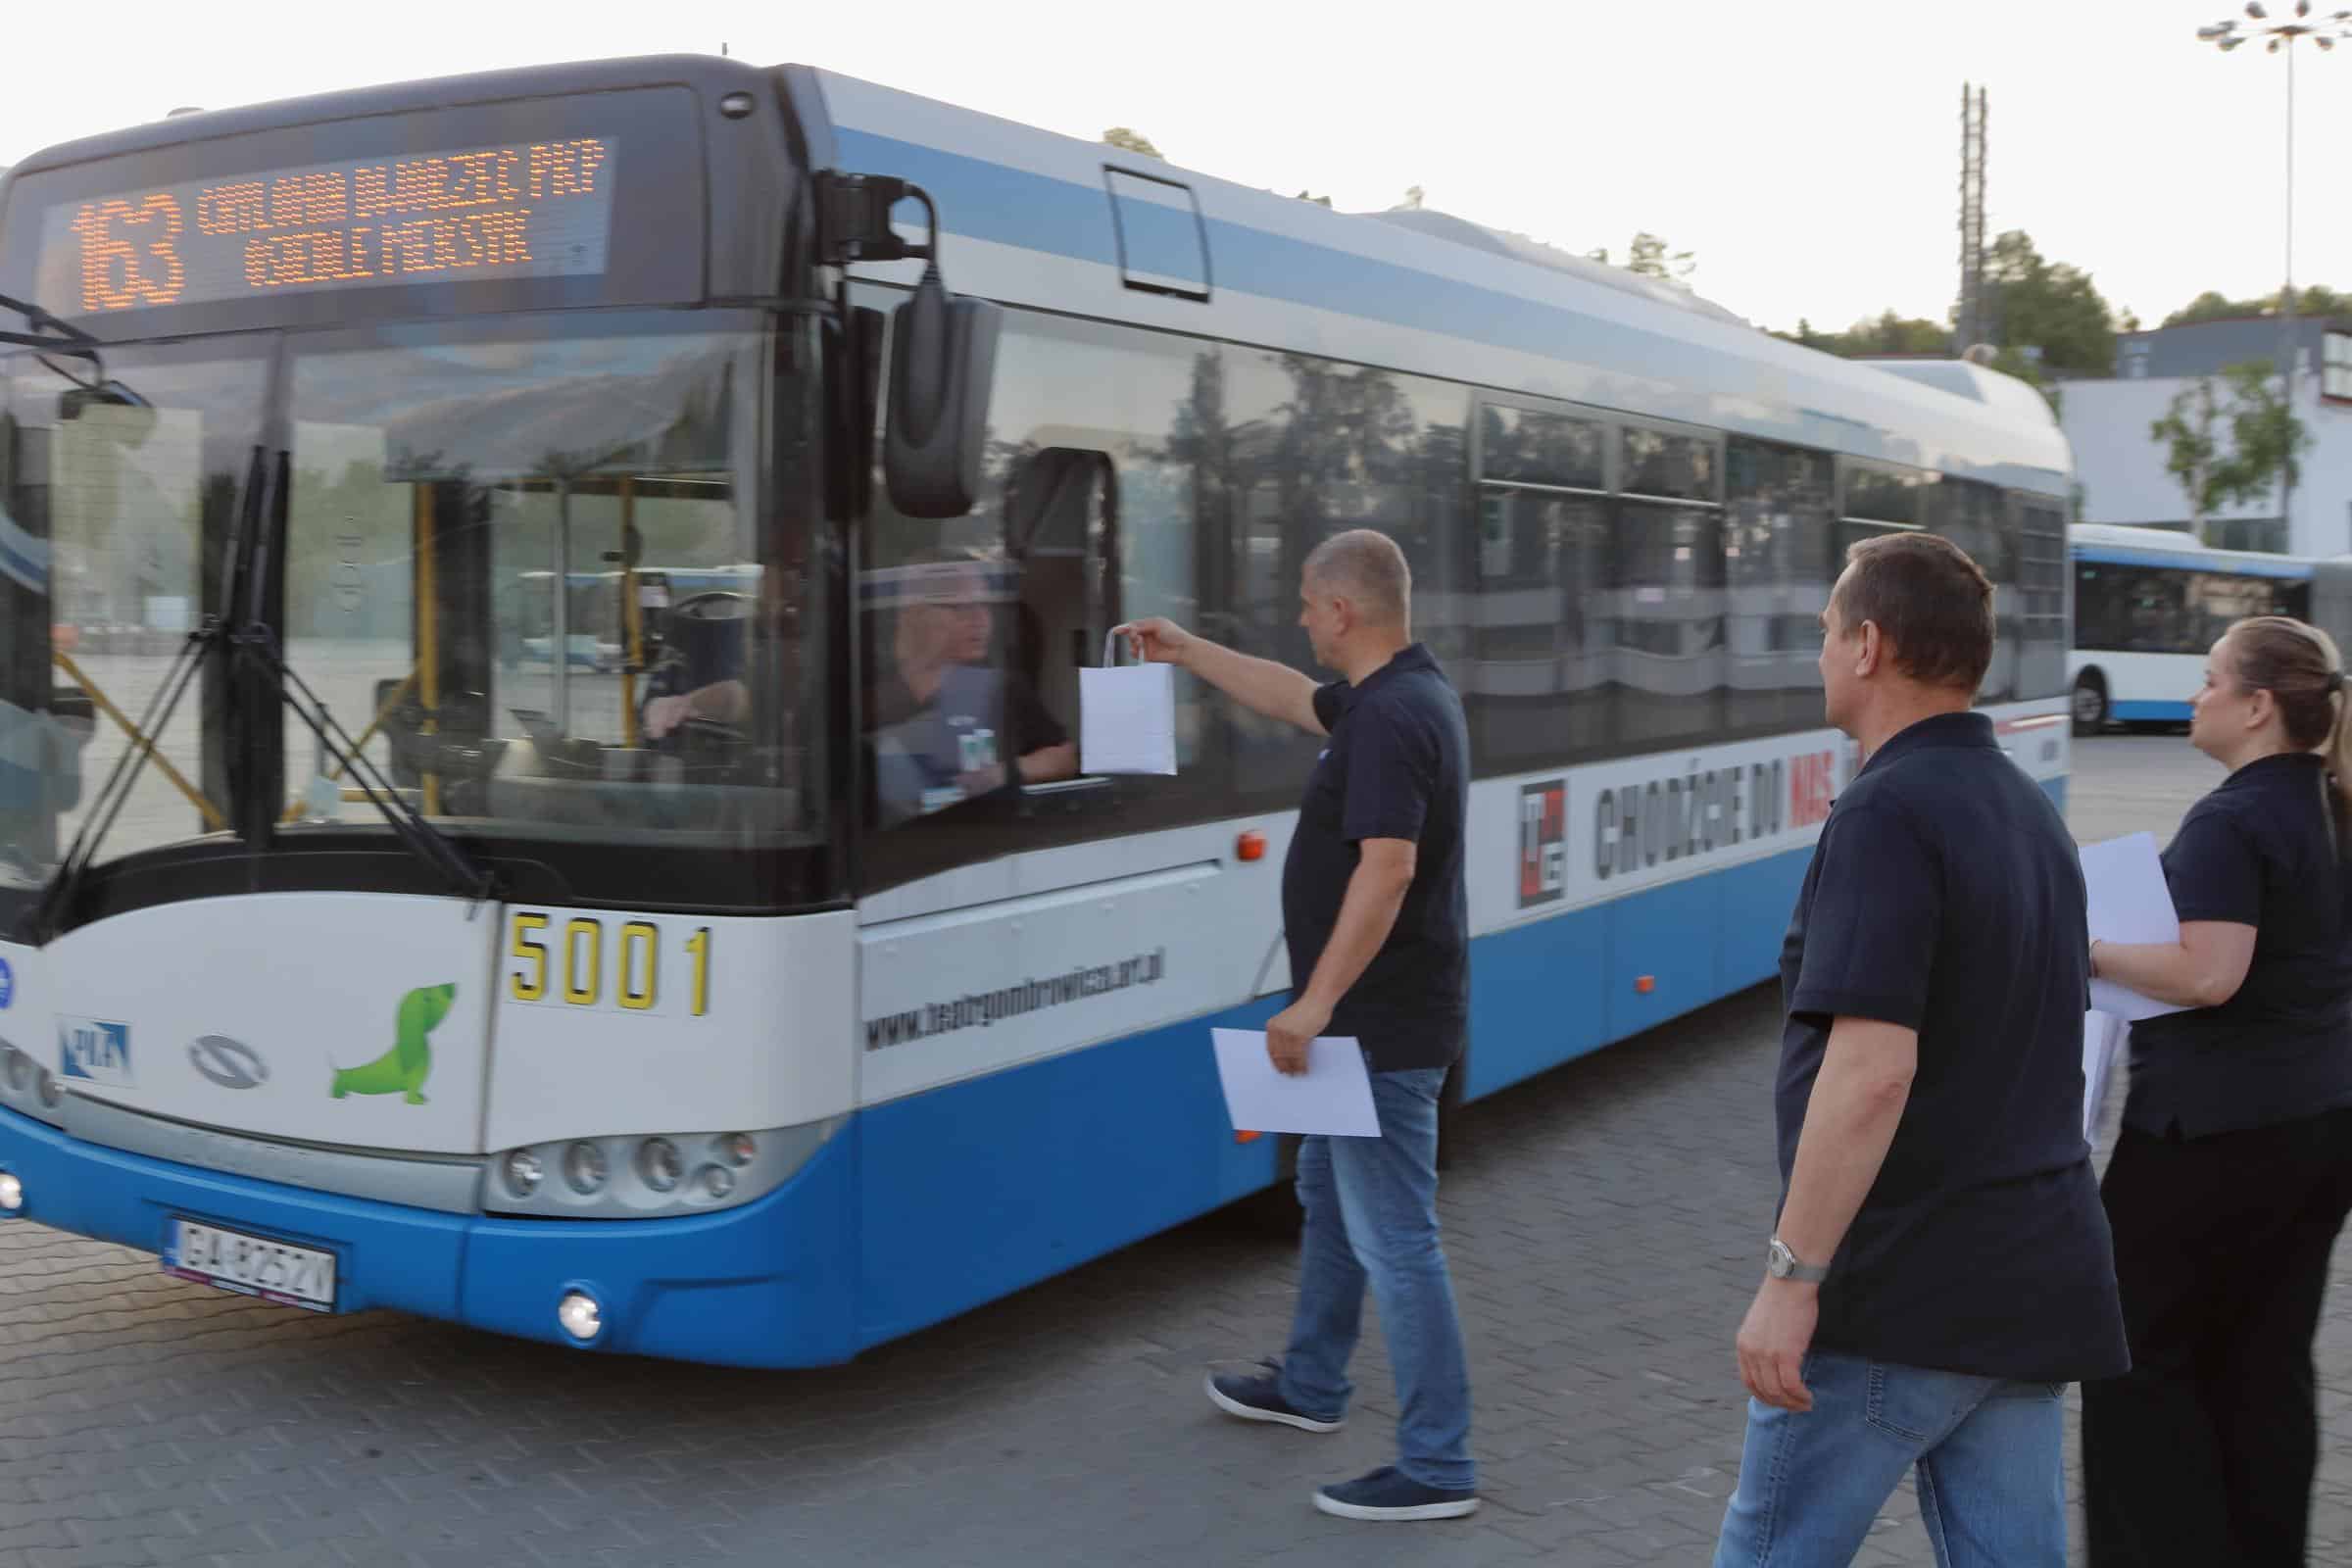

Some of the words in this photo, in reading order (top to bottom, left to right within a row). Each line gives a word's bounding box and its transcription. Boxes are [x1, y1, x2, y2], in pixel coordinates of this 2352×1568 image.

[530, 139, 605, 197] PKP
[69, 194, 186, 312] 163
[1748, 759, 1783, 840] DO
[511, 911, 712, 1017] 5001
